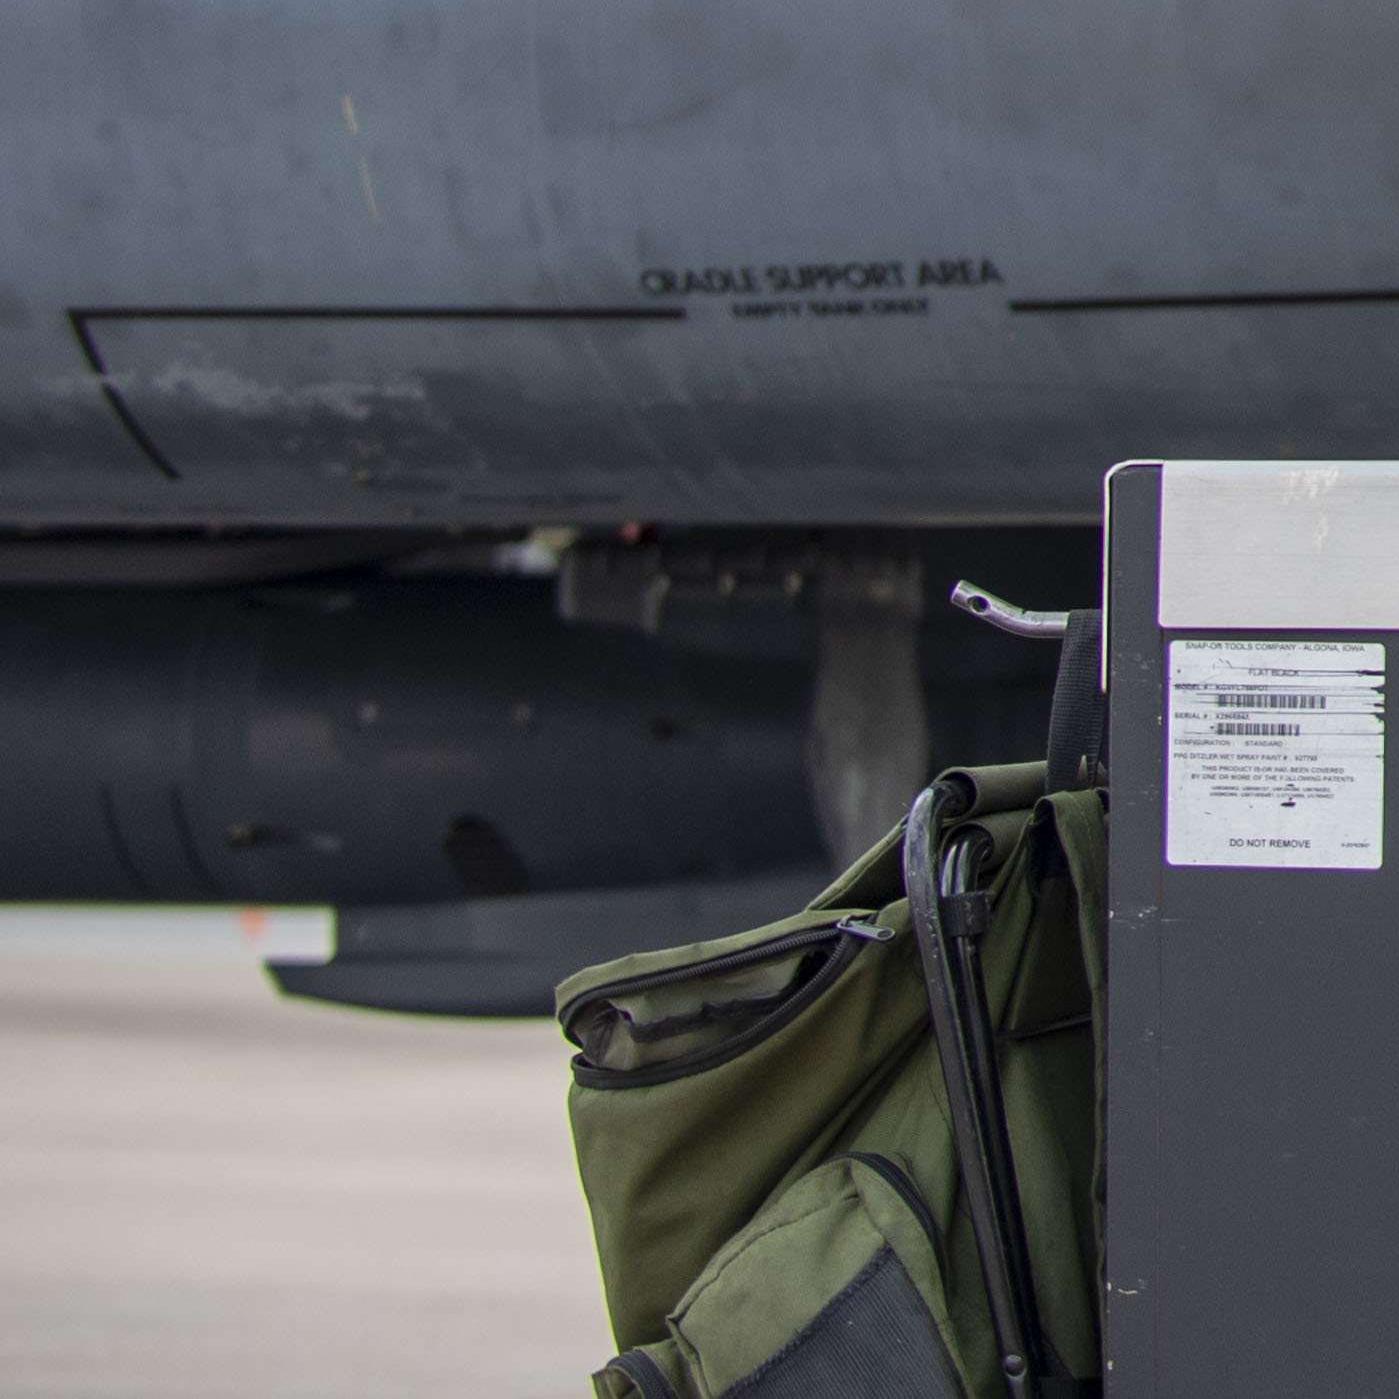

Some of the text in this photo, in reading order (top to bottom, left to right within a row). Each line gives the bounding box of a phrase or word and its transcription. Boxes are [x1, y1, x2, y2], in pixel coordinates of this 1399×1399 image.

[639, 258, 1004, 295] CRADLE SUPPORT AREA
[1225, 642, 1253, 651] TOOLS
[1255, 643, 1296, 652] COMPANY
[1342, 644, 1366, 653] IOWA
[1249, 668, 1268, 677] FLAT
[1174, 712, 1200, 720] SERIAL
[1245, 740, 1284, 748] STANDARD
[1220, 753, 1235, 761] WET
[1236, 753, 1259, 761] SPRAY
[1261, 754, 1281, 762] PAINT
[1219, 765, 1252, 773] PRODUCT
[1290, 766, 1309, 774] BEEN
[1191, 773, 1200, 781] BY
[1202, 773, 1216, 781] ONE
[1229, 838, 1311, 849] DO NOT REMOVE
